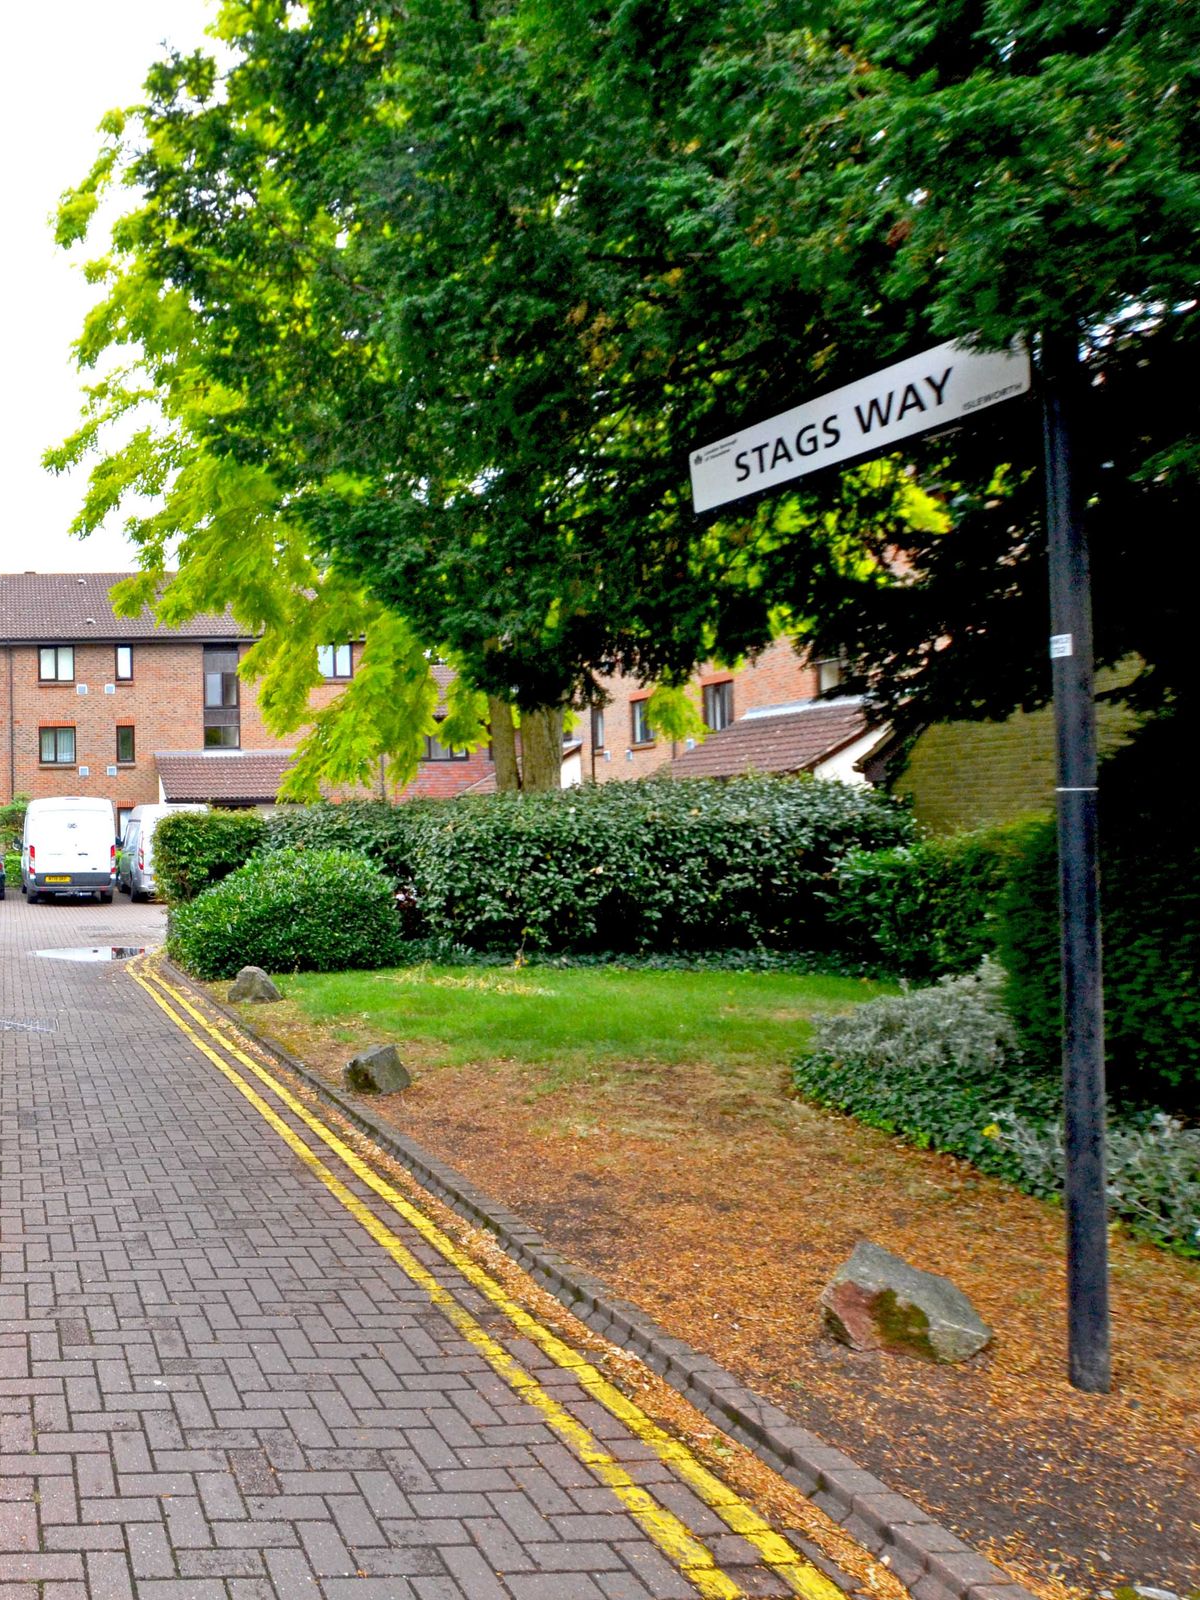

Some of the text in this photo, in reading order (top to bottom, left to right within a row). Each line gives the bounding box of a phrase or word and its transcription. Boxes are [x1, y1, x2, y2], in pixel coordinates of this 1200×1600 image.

[734, 366, 954, 482] STAGS WAY
[962, 382, 1023, 411] ISLEWORTH
